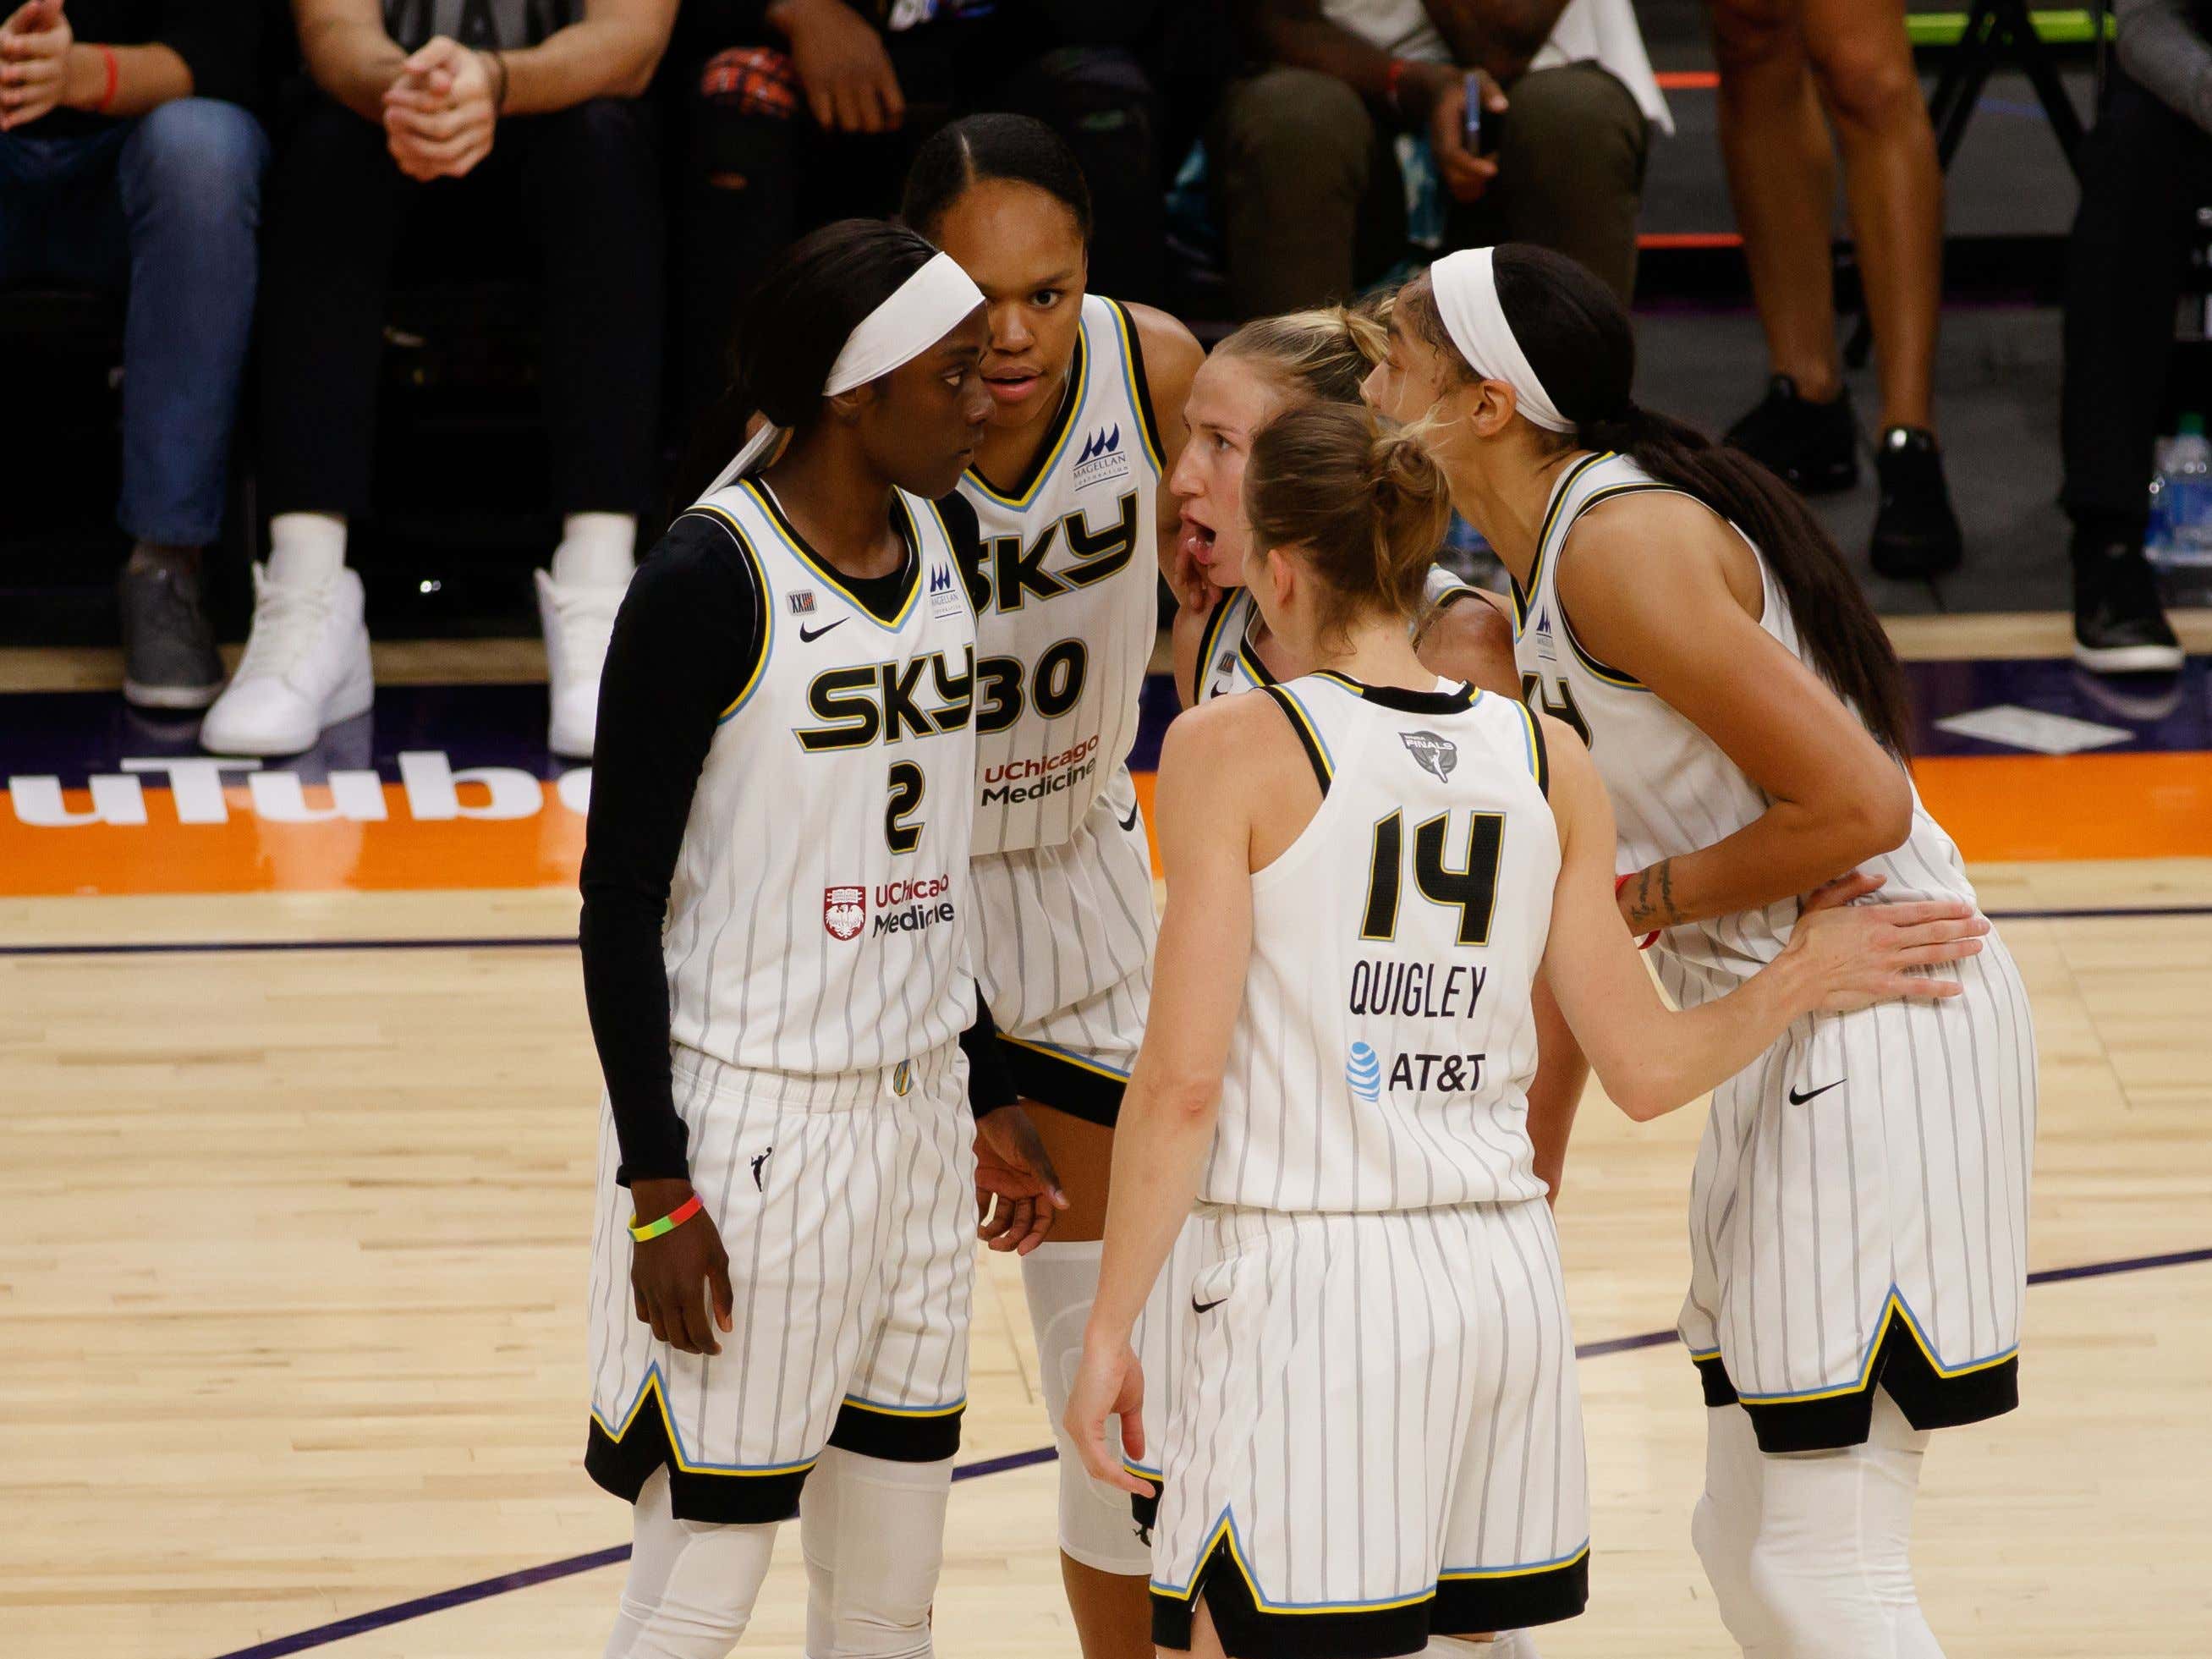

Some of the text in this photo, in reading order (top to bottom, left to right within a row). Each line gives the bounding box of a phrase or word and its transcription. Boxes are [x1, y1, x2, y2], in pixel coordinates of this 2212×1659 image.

[1073, 454, 1127, 479] MAGELLAN
[976, 488, 1139, 616] KY
[792, 643, 974, 752] SKY
[976, 637, 1089, 735] 30
[985, 734, 1099, 783] UChicago
[1405, 739, 1454, 750] FINALS
[885, 760, 925, 855] 2
[981, 758, 1097, 807] Medicine
[875, 873, 949, 908] UChicao
[1358, 805, 1507, 947] 14
[1349, 960, 1487, 1019] QUIGLEY
[1388, 1052, 1486, 1092] AT&T
